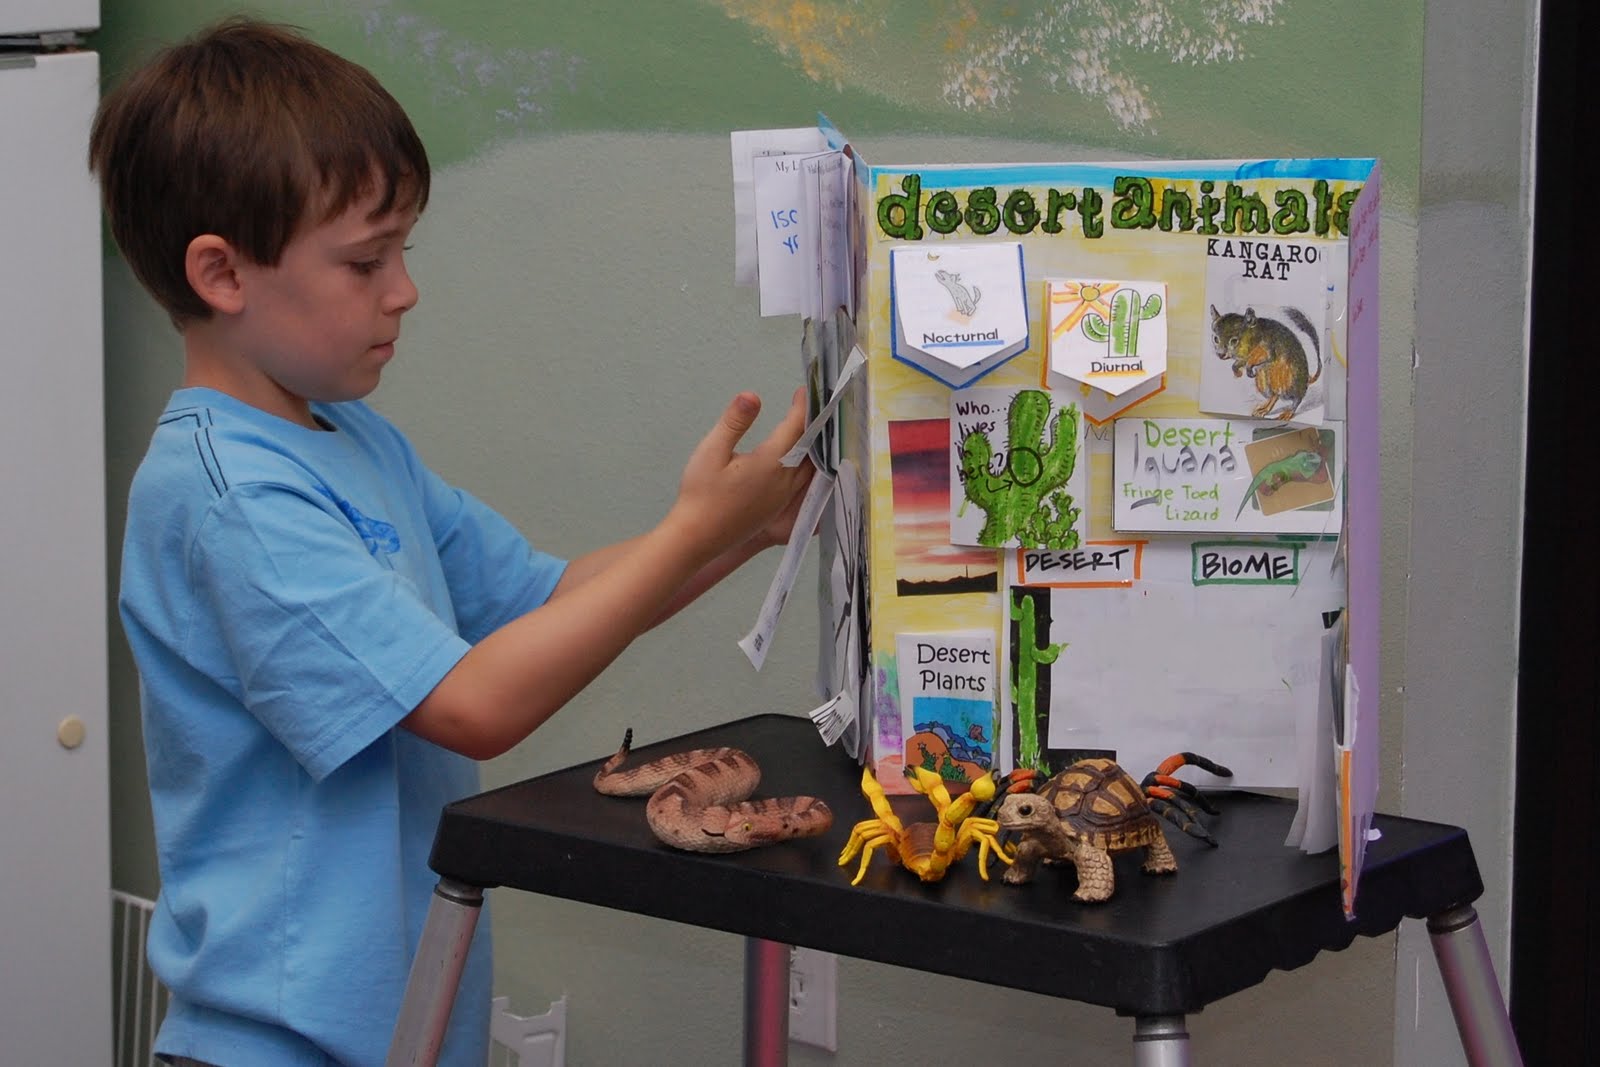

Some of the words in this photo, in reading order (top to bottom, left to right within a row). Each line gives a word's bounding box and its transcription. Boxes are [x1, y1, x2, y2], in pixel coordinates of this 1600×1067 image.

[876, 173, 1104, 240] desert
[1206, 238, 1322, 264] KANGARO
[1242, 260, 1290, 280] RAT
[922, 328, 999, 344] Nocturnal
[1091, 360, 1143, 373] Diurnal
[958, 421, 996, 440] lives
[1142, 420, 1236, 449] Desert
[1131, 432, 1239, 510] Iguana
[1122, 482, 1174, 506] Fringe
[1181, 483, 1220, 500] Toed
[1165, 505, 1220, 521] Lizard
[1025, 548, 1130, 573] DESERT
[917, 643, 991, 665] Desert
[919, 670, 986, 692] Plants
